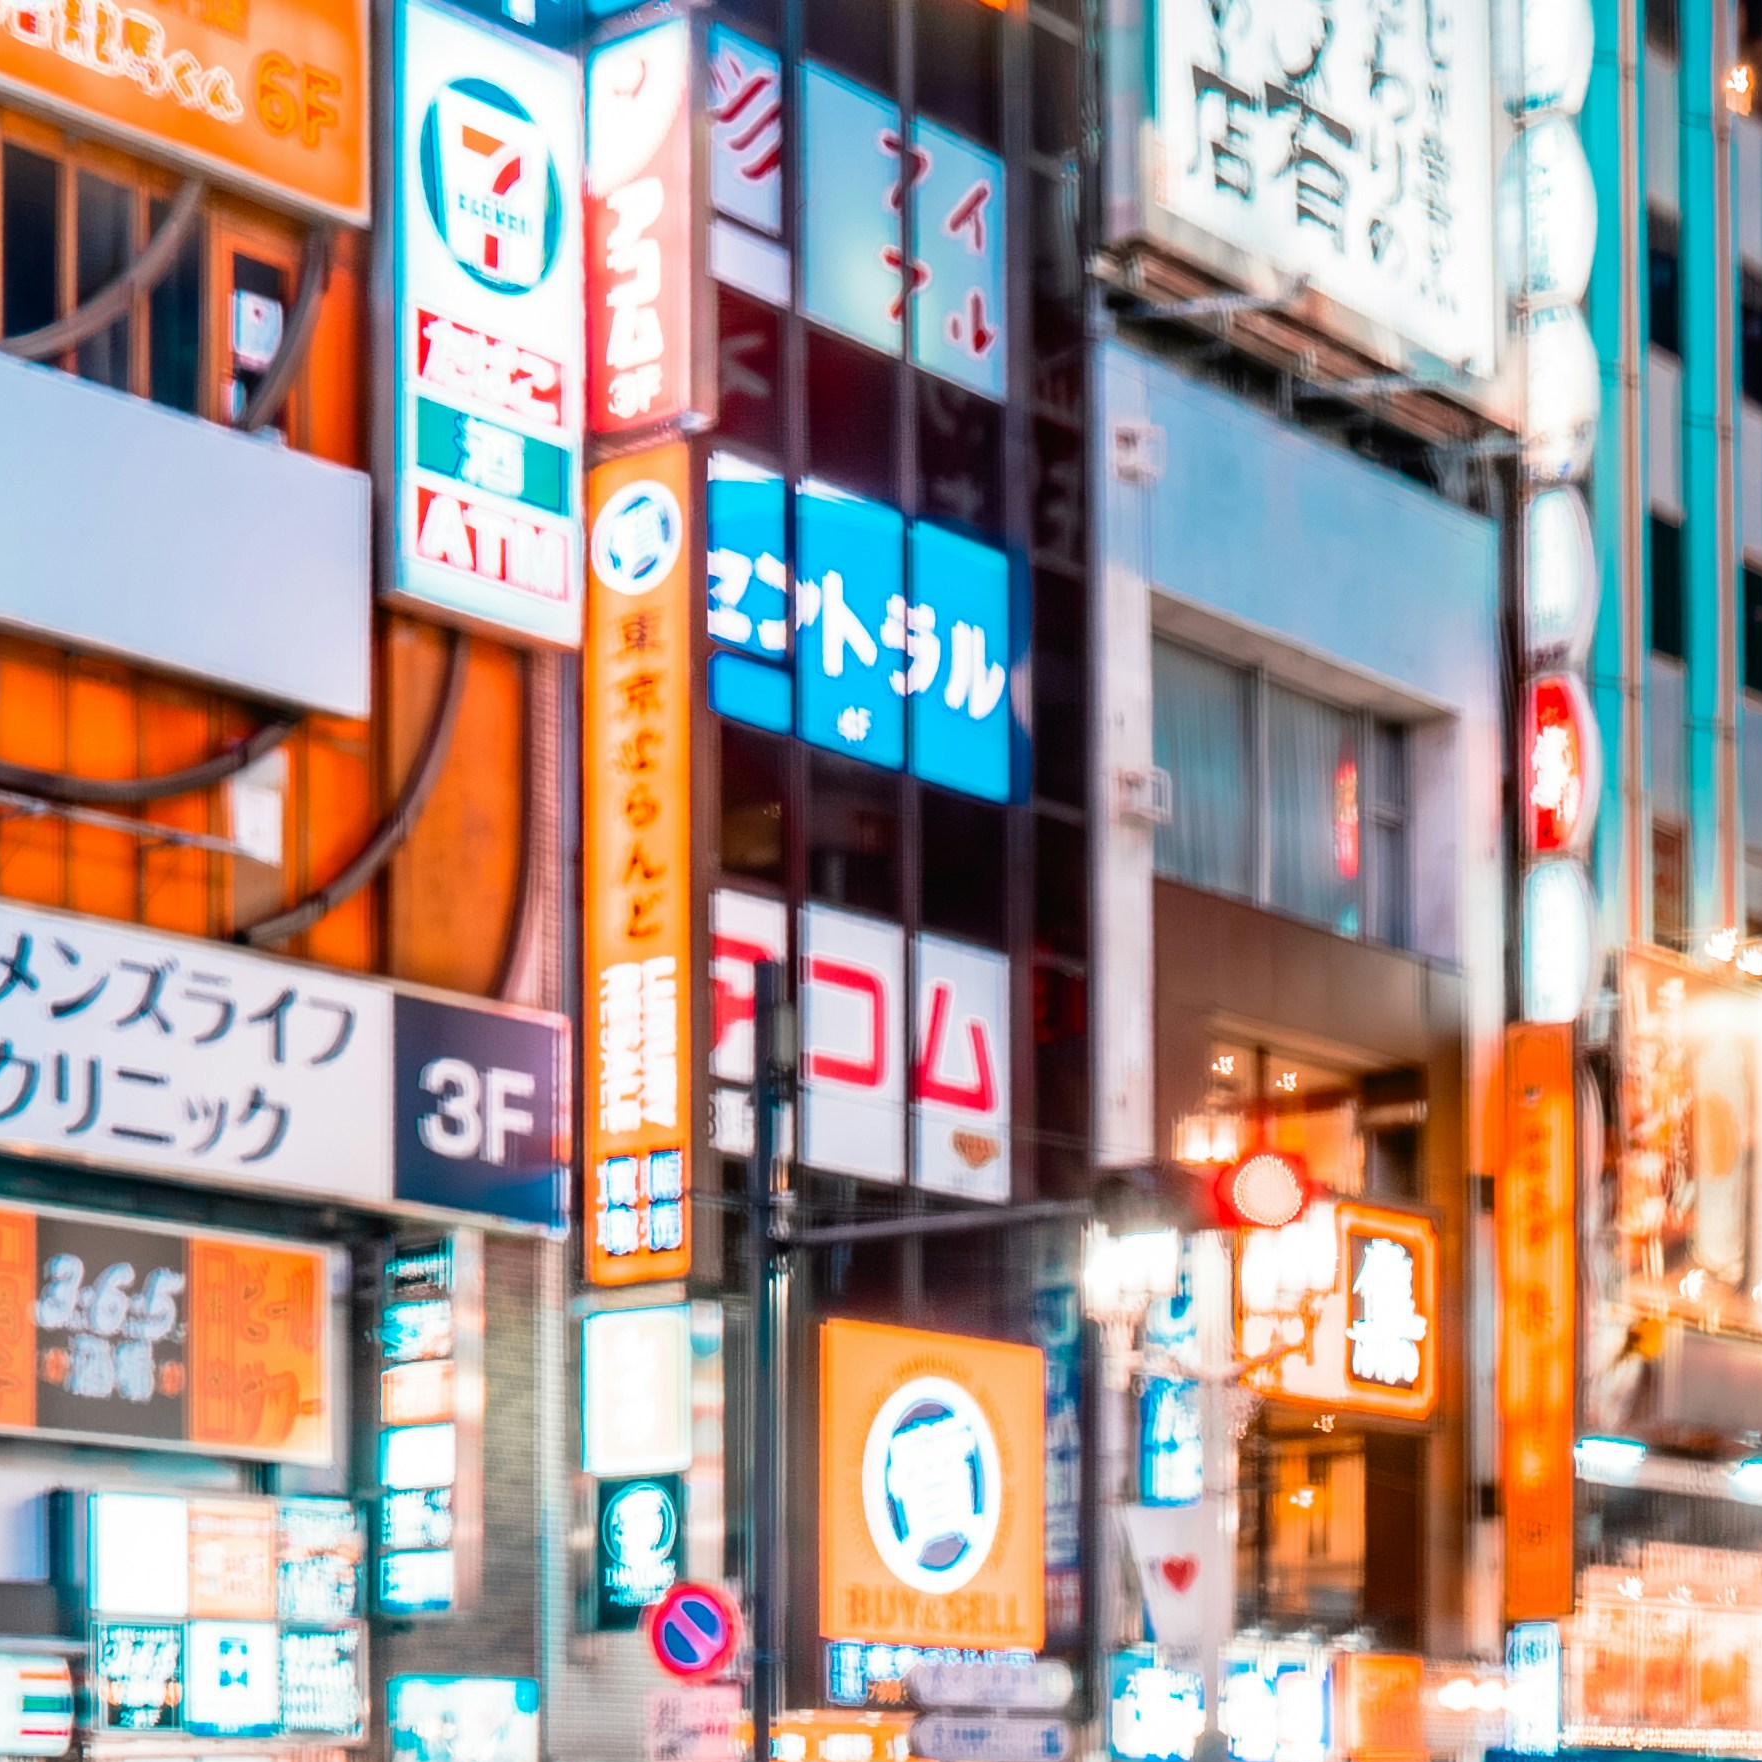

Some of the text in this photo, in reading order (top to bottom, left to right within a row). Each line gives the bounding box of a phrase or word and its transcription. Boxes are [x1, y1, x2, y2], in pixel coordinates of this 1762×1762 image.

[254, 50, 342, 149] 6F
[421, 310, 561, 424] たばこ
[462, 415, 527, 498] 酒
[419, 488, 569, 600] ATM
[415, 1056, 536, 1166] 3F
